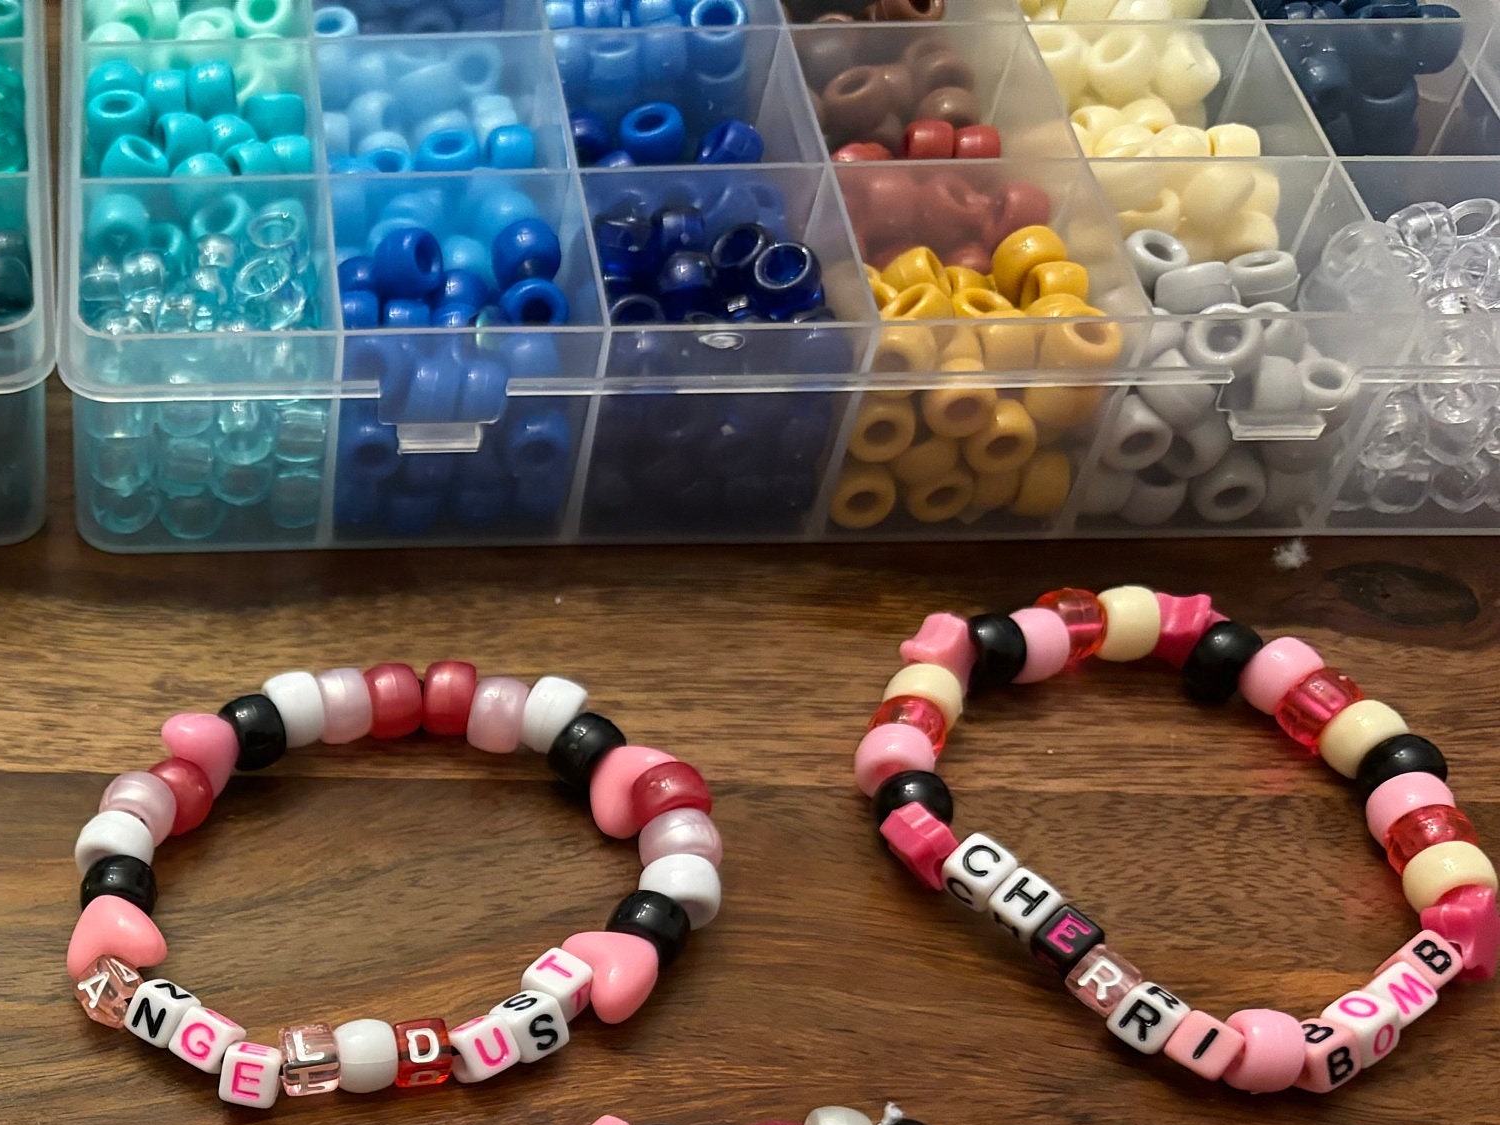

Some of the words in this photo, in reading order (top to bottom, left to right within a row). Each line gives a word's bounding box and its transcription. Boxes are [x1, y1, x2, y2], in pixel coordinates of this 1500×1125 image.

[77, 955, 329, 1100] ANGEL
[404, 947, 593, 1087] DUST
[948, 842, 1219, 1062] CHERRI
[1304, 937, 1454, 1085] BOMB
